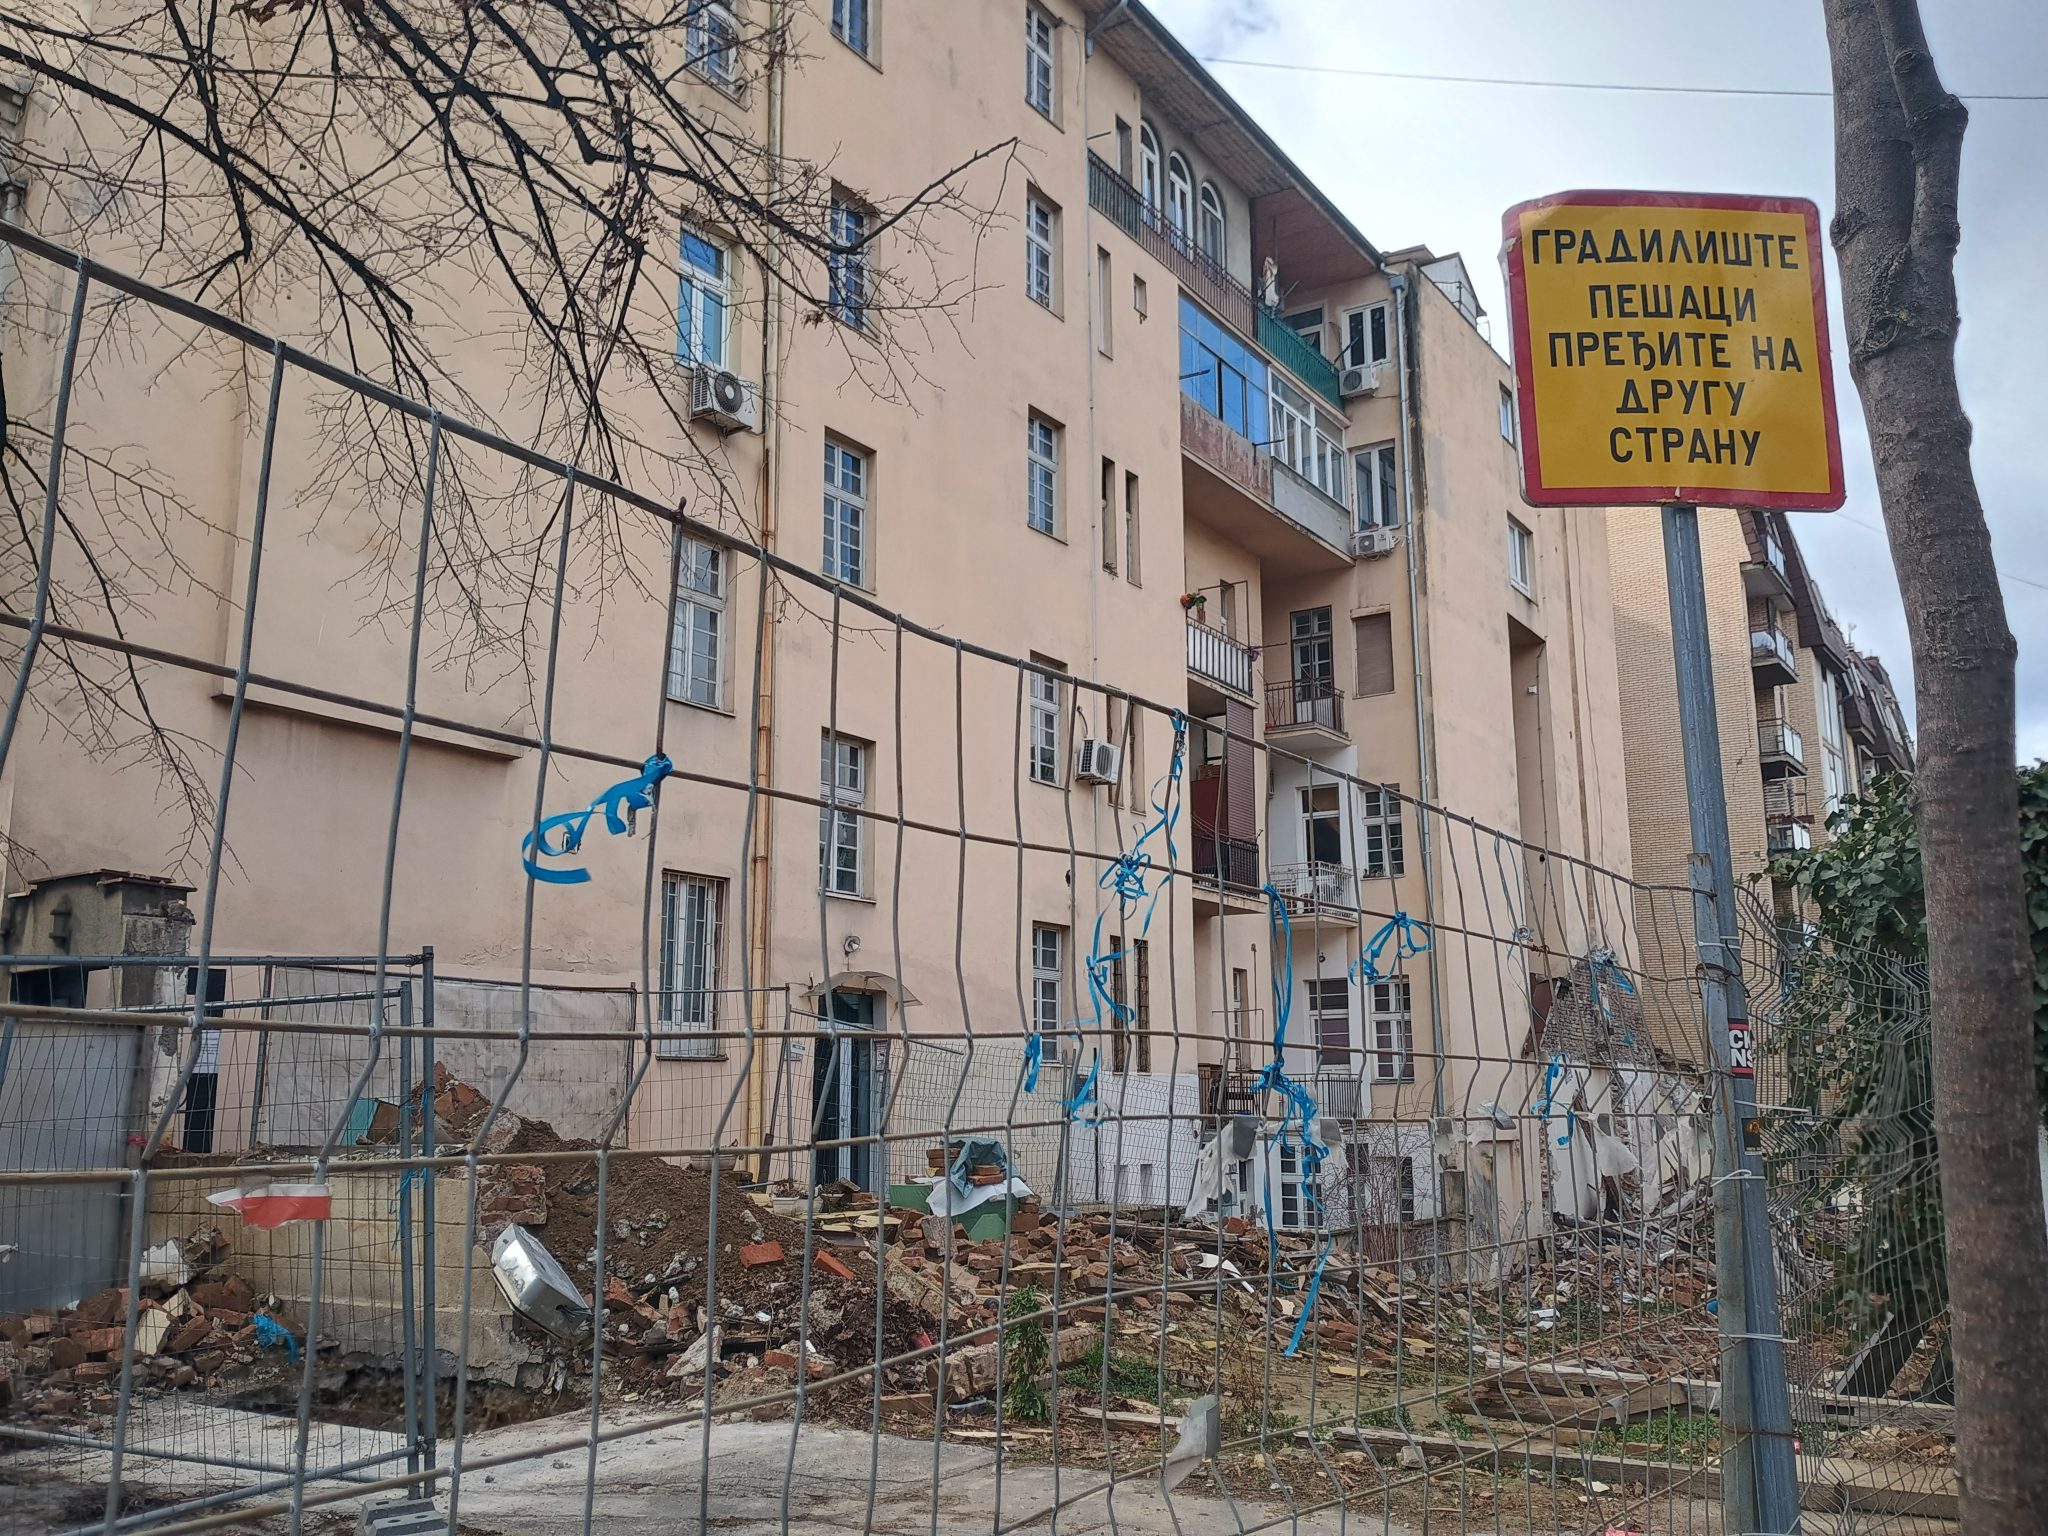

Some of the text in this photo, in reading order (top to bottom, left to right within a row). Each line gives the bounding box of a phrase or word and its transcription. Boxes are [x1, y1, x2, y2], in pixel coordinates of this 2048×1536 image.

[1531, 228, 1799, 270] ГРАДИЛИШТЕ
[1588, 284, 1757, 327] ПЕШАЦИ
[1548, 331, 1803, 373] ПРЕЂИТЕ НА
[1615, 379, 1746, 417] ДРУГУ
[1609, 426, 1761, 467] СТРАНУ
